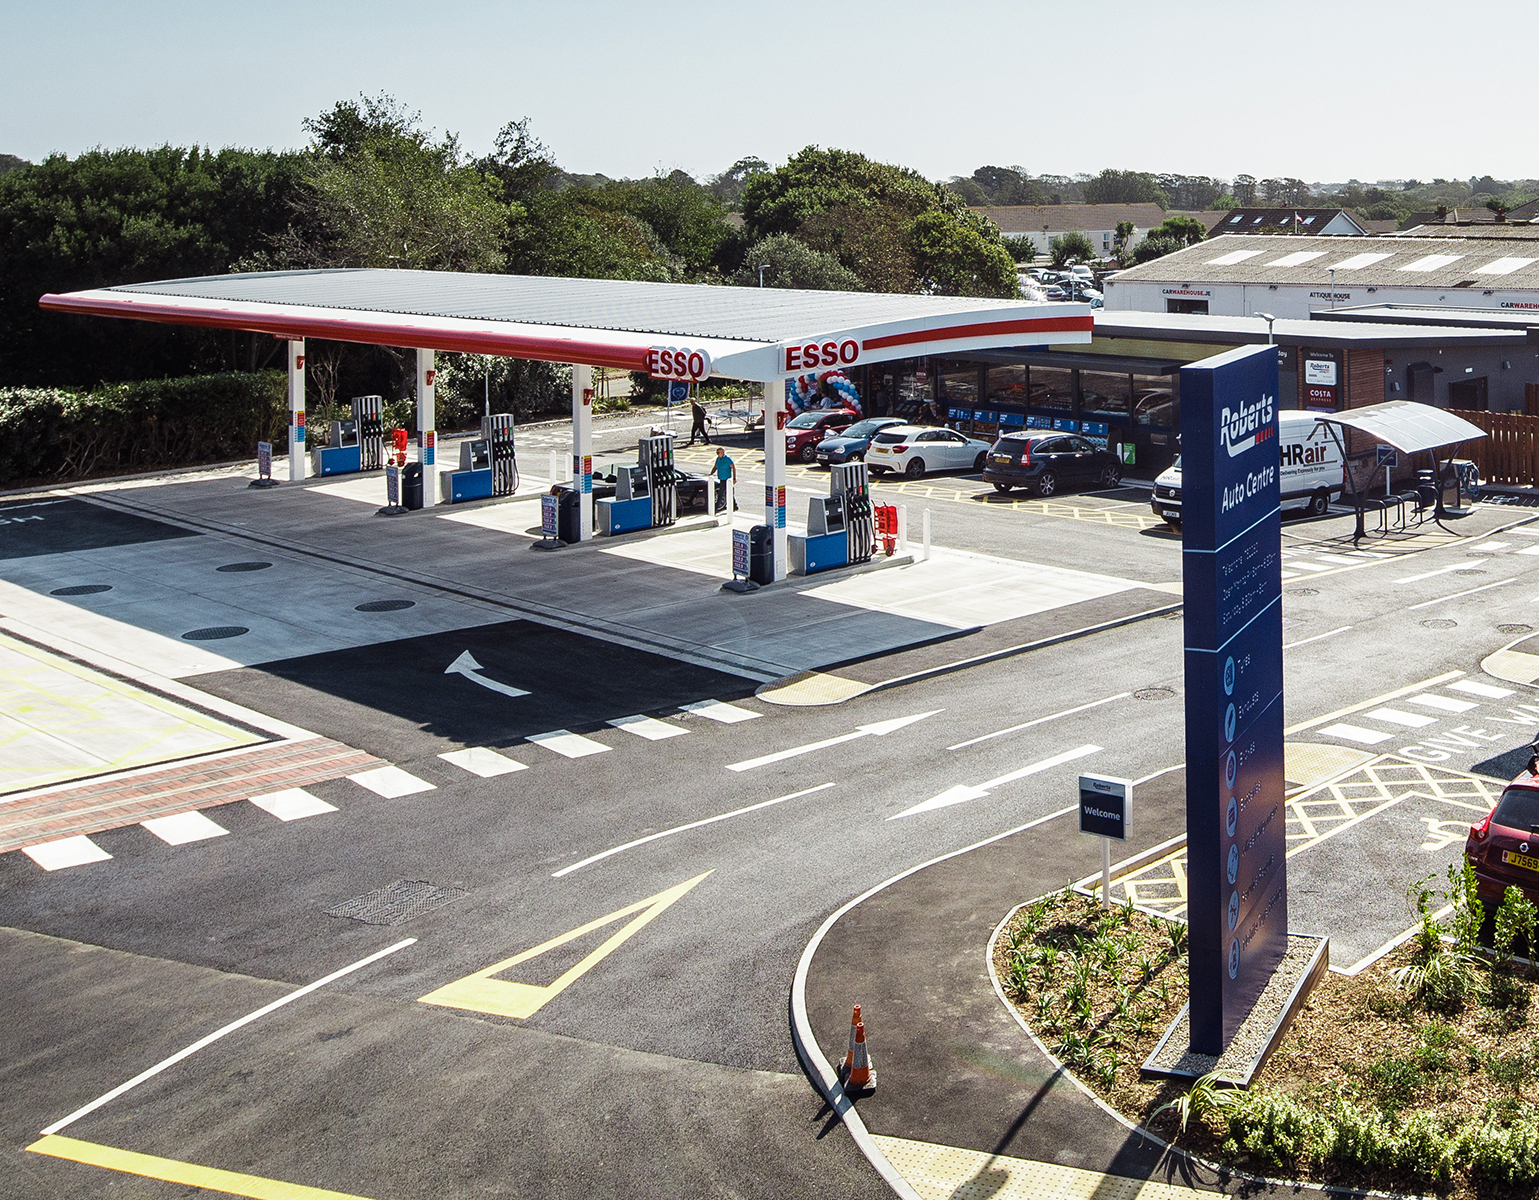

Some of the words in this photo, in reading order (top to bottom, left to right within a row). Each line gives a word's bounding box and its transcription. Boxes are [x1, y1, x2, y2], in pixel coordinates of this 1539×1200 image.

[650, 350, 704, 379] ESSO
[785, 339, 860, 371] ESSO
[1310, 362, 1330, 371] Roberts
[1310, 390, 1331, 398] COSTA
[1220, 393, 1273, 458] Roberts
[1221, 482, 1245, 514] Auto
[1246, 465, 1275, 498] Centre
[1398, 725, 1507, 762] GIVE
[1084, 805, 1121, 821] Welcome
